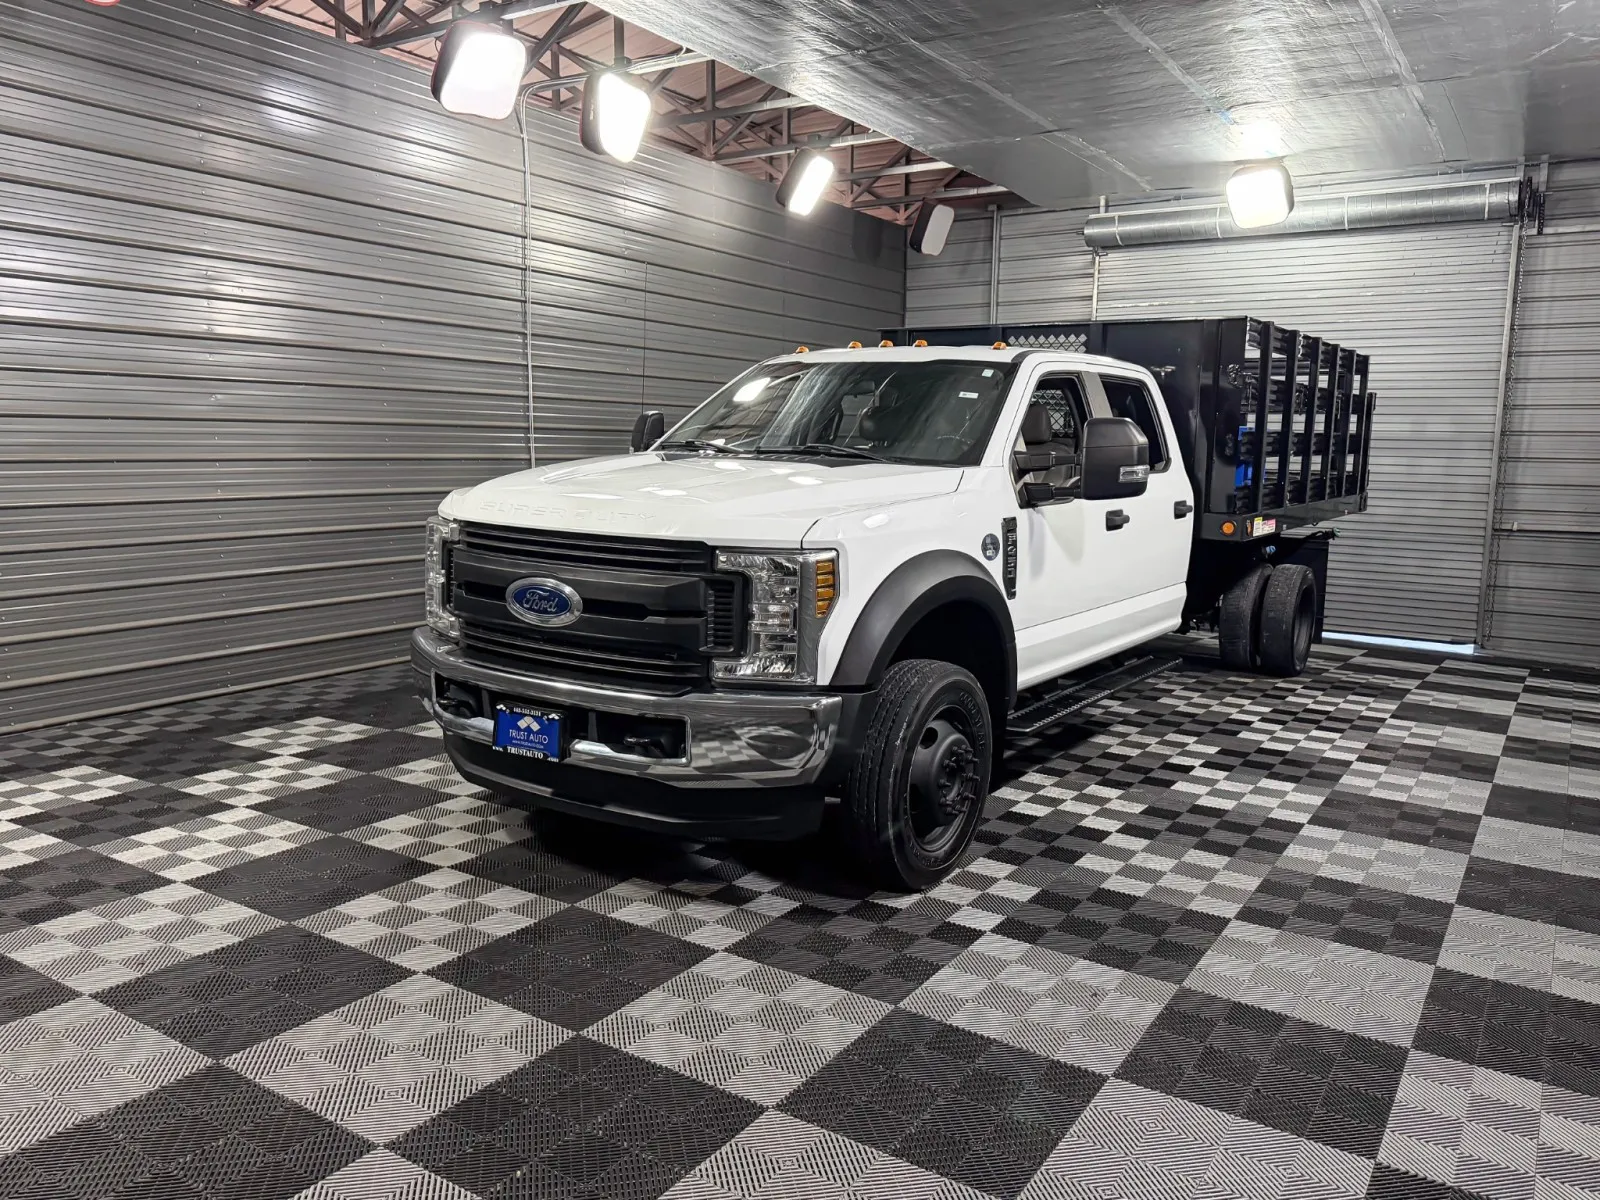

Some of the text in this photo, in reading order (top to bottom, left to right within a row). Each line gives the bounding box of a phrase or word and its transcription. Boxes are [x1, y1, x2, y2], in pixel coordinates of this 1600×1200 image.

[478, 500, 656, 523] SUPER DUTY
[522, 589, 559, 612] Ford
[509, 729, 549, 744] TRUST AUTO
[507, 746, 543, 759] TRUSTAUTO
